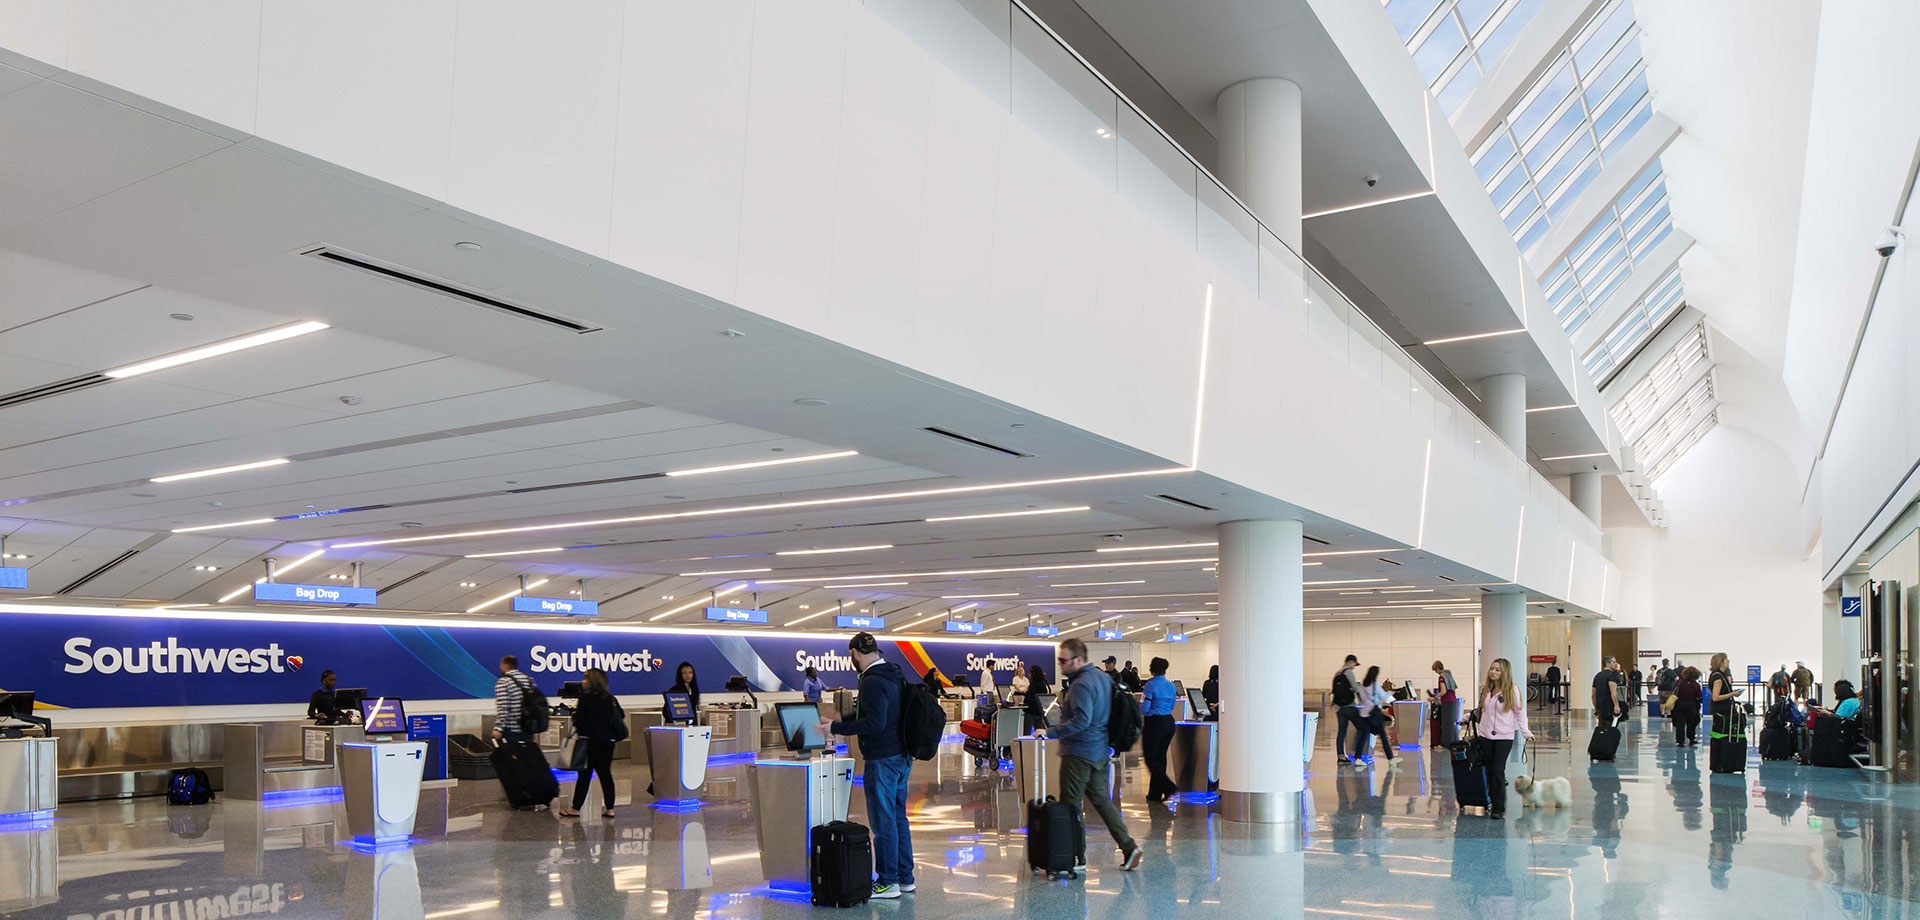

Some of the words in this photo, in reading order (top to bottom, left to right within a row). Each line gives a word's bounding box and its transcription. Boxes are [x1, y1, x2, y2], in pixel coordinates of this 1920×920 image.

[296, 587, 315, 600] Bag
[317, 589, 339, 600] Drop
[541, 600, 555, 611] Bag
[556, 601, 572, 612] Drop
[64, 637, 284, 674] Southwest
[531, 645, 651, 672] Southwest
